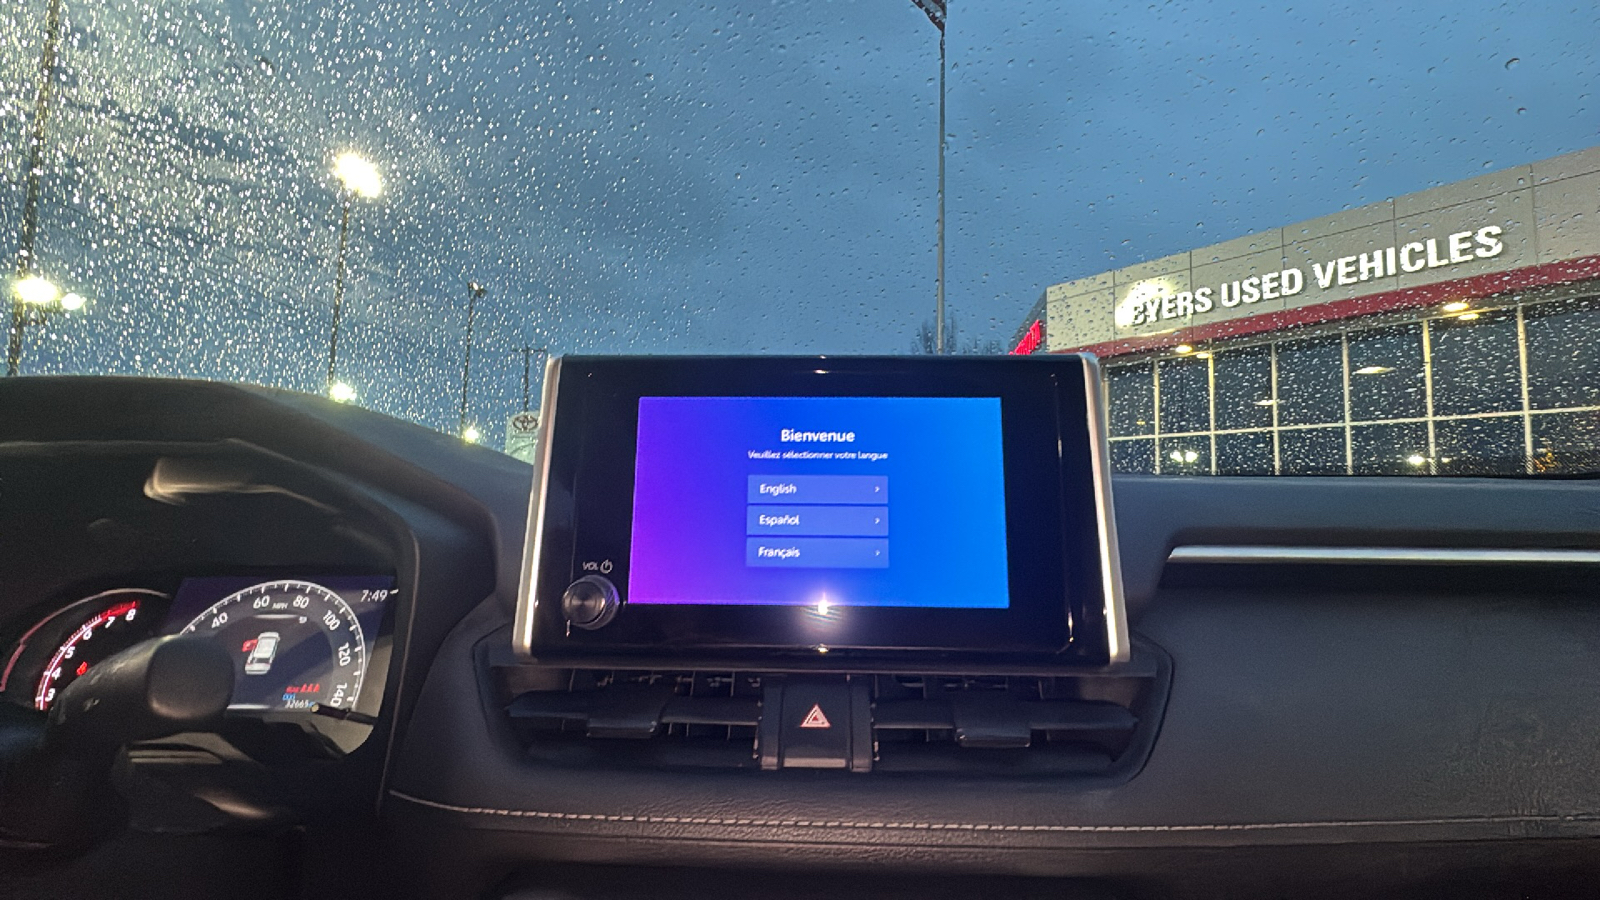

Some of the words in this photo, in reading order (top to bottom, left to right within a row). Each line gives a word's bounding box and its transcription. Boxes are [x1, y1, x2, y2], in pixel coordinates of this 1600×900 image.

[1220, 267, 1303, 308] USED
[1312, 225, 1503, 289] VEHICLES
[780, 428, 856, 443] Bienvenue
[747, 450, 781, 460] Veuillez
[782, 450, 834, 460] sélectionner
[834, 451, 857, 460] votre
[857, 451, 888, 462] langue
[759, 483, 797, 496] English
[758, 514, 800, 527] Español
[757, 546, 800, 560] Français
[582, 561, 599, 571] VOL
[253, 595, 271, 609] 60
[292, 594, 310, 609] 80
[360, 589, 388, 602] 7:49
[125, 608, 136, 621] 8
[211, 612, 228, 629] 40
[322, 609, 341, 631] 100
[105, 616, 116, 629] 7
[64, 646, 76, 659] 5
[337, 642, 351, 667] 120
[51, 667, 62, 680] 4
[46, 687, 57, 701] 3
[329, 682, 349, 708] 140
